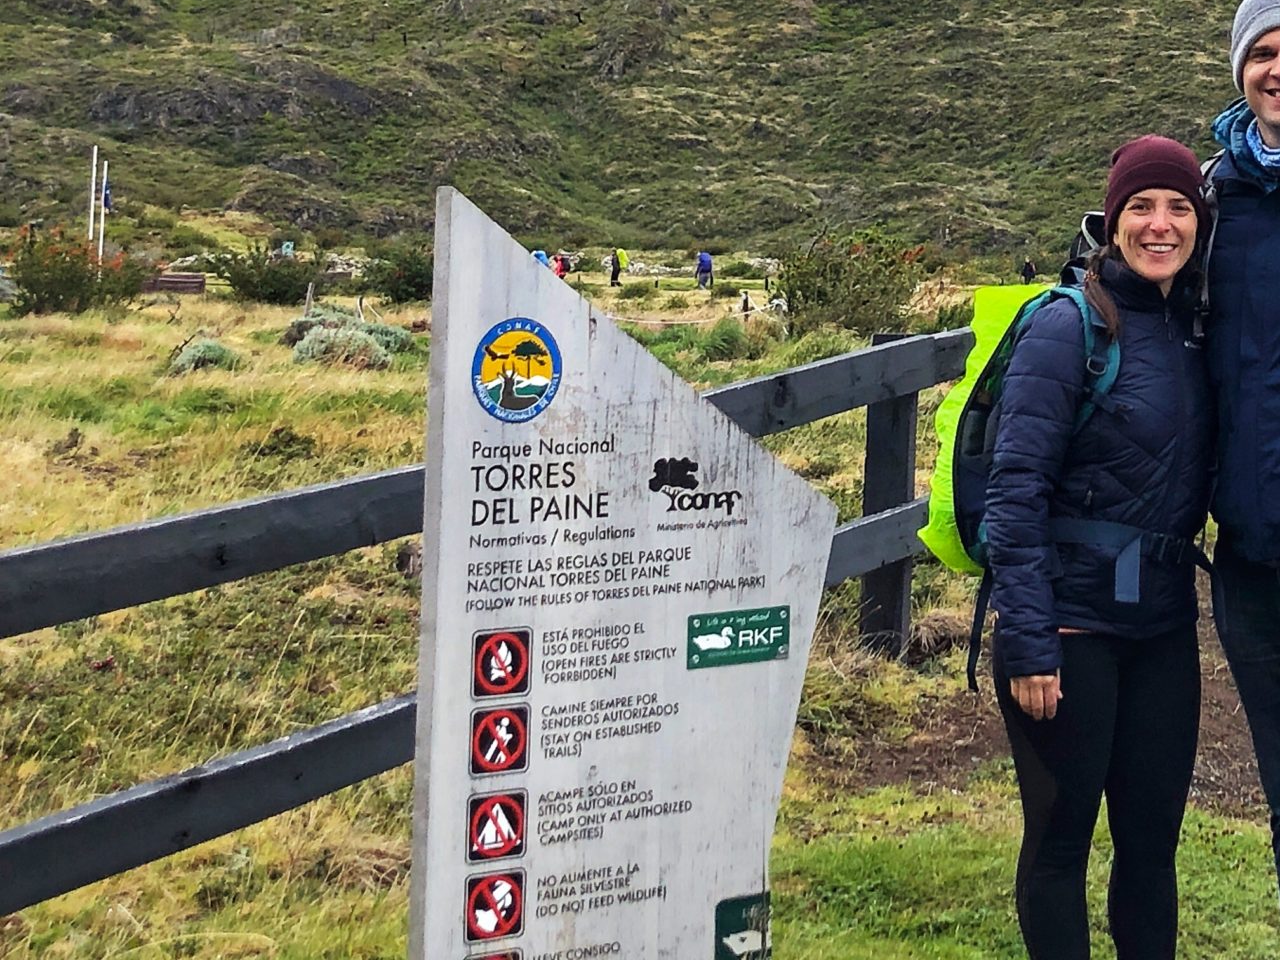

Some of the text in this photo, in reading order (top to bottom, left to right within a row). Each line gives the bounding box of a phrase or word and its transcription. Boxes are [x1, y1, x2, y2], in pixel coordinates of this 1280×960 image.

[497, 322, 540, 334] CONAF
[472, 433, 615, 463] Parque Nacional
[471, 461, 576, 492] TORRES
[471, 492, 609, 526] DEL PAINE
[678, 490, 742, 515] conaf
[470, 525, 635, 549] Normativas / Regulations
[657, 521, 694, 531] Ministerio
[696, 520, 705, 529] de
[468, 546, 692, 576] RESPETE LAS REGLAS DEL PARQUE
[467, 564, 670, 593] NACIONAL TORRES DEL PAINE
[466, 597, 514, 613] (FOLLOW
[518, 595, 538, 606] THE
[541, 593, 572, 605] RULES
[575, 591, 589, 603] OF
[592, 588, 629, 601] TORRES
[633, 586, 650, 597] DEL
[653, 582, 682, 595] PAINE
[685, 578, 736, 591] NATIONAL
[543, 622, 645, 643] ESTÁ PROHIBIDO EL
[738, 626, 783, 647] RKF
[542, 637, 629, 656] USO DEL FUEGO
[541, 647, 677, 674] (OPEN FIRES ARE STRICTLY
[541, 693, 658, 717] CAMINE SIEMPRE POR
[541, 702, 679, 730] SENDEROS AUTORIZADOS
[540, 722, 661, 748] (STAY ON ESTABLISHED
[544, 742, 582, 759] TRAILS)
[538, 780, 636, 804] ACAMPE SÓLO EN
[538, 790, 653, 817] SITIOS AUTORIZADOS
[537, 800, 692, 835] (CAMP ONLY AT AUTHORIZED
[540, 826, 604, 846] CAMPSITES)
[537, 863, 640, 888] NO ALIMENTE A LA
[537, 877, 630, 901] FAUNA SILVESTRE
[535, 885, 667, 919] (DO NOT FEED WILDLIFE)
[566, 941, 620, 960] CONSIGO
